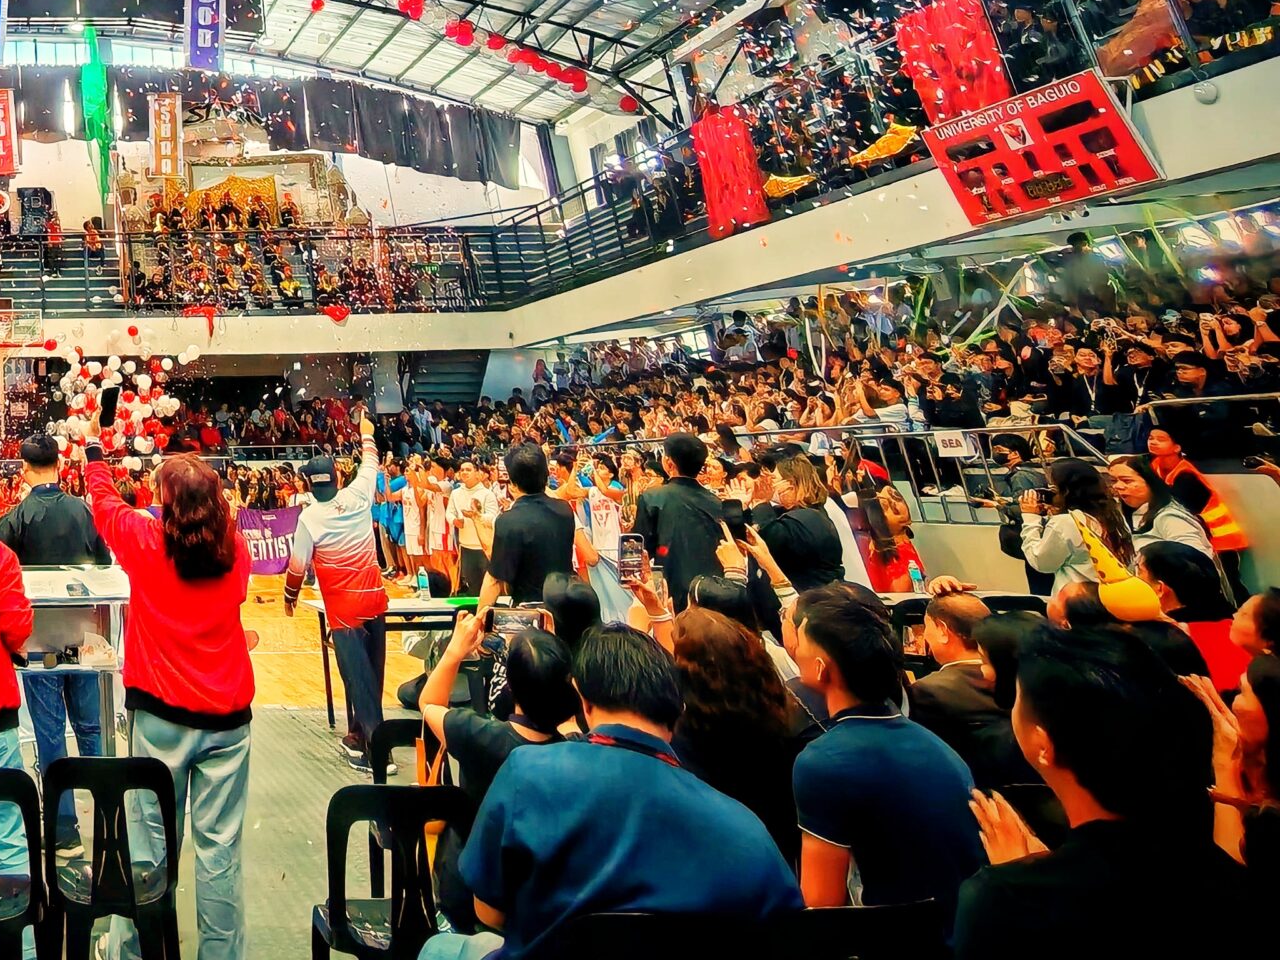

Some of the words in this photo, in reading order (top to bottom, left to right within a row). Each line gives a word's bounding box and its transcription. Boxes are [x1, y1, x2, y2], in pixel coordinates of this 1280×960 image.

[934, 107, 1004, 140] UNIVERSITY
[1006, 99, 1025, 116] OF
[1026, 80, 1081, 109] BAGUIO
[941, 438, 963, 449] SEA
